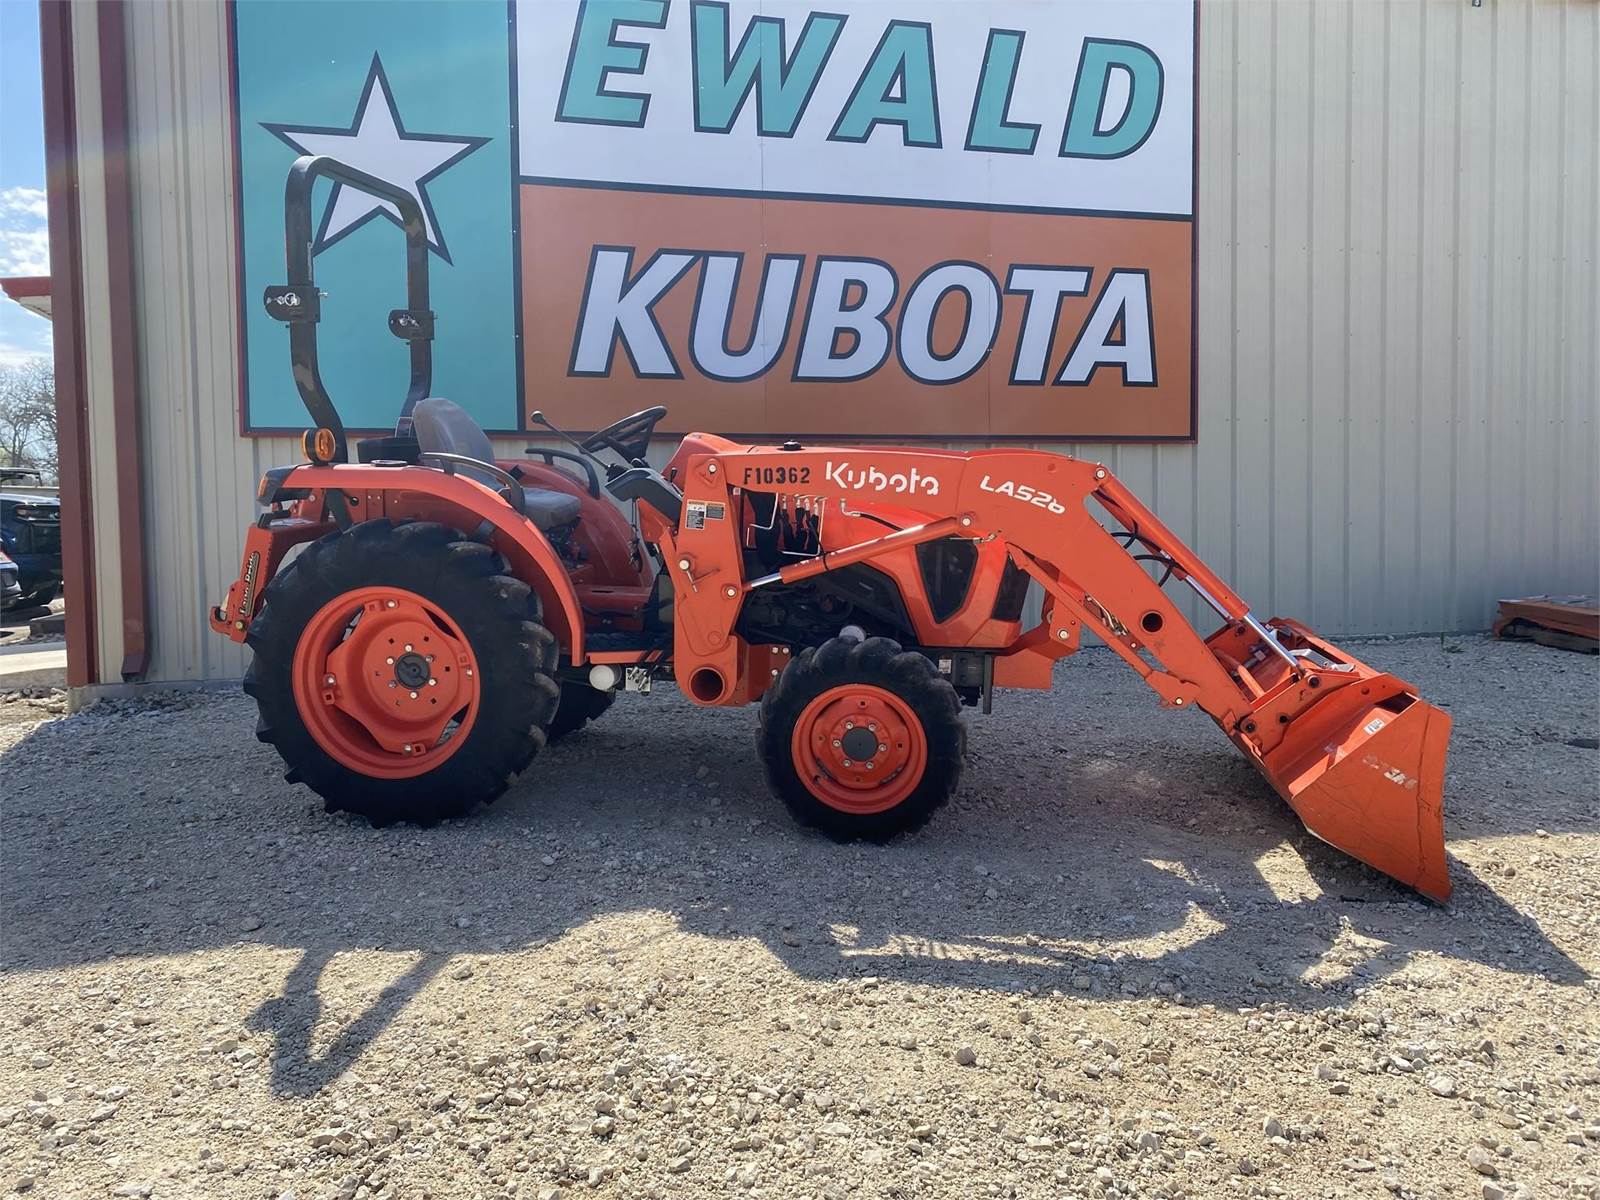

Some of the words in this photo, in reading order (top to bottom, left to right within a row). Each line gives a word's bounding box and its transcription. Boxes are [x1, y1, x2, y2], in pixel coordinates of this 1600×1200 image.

[555, 0, 1165, 160] EWALD
[567, 245, 1158, 388] KUBOTA
[743, 467, 811, 485] F10362
[825, 461, 940, 496] Kubota
[979, 474, 1066, 514] LA526
